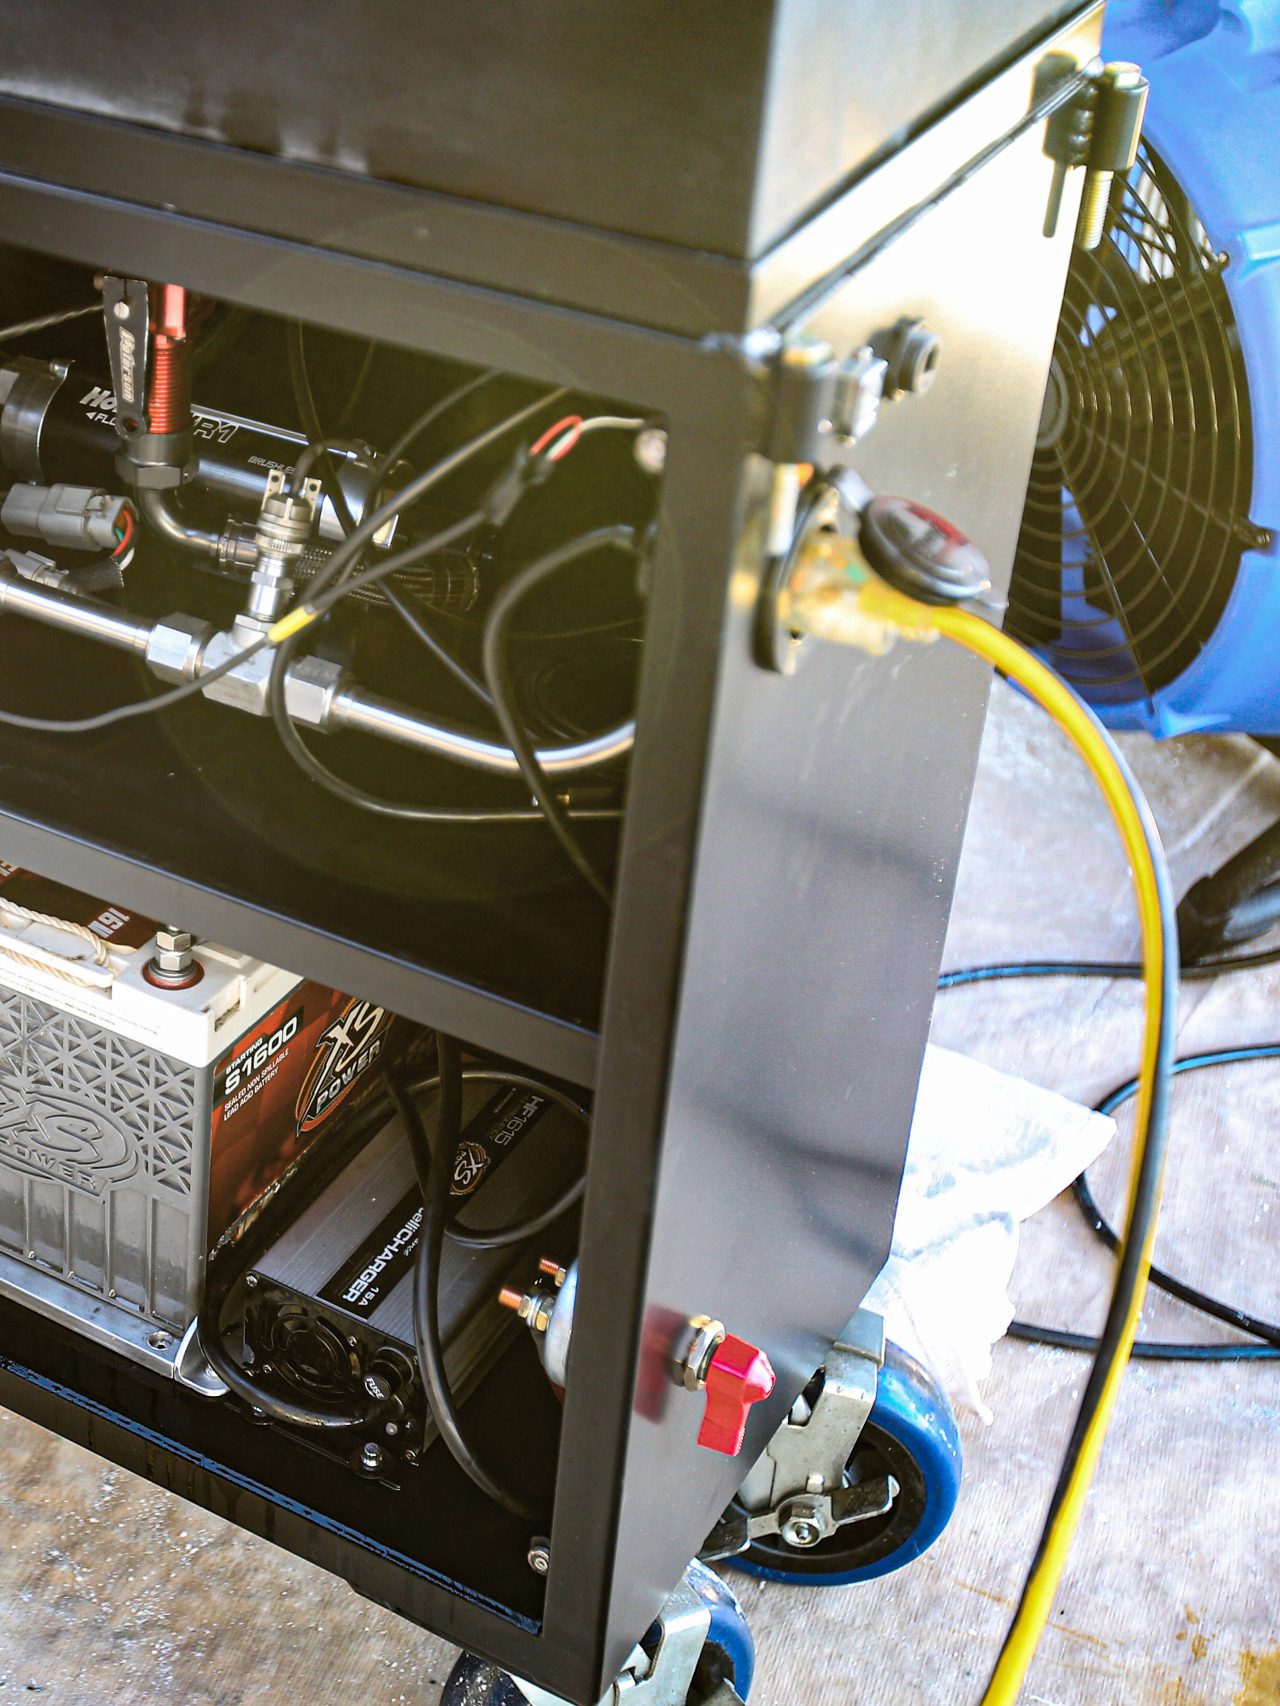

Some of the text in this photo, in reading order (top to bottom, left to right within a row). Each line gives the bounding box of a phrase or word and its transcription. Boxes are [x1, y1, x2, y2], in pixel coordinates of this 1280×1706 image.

[191, 413, 239, 444] R1
[87, 907, 130, 938] 16V
[225, 1037, 264, 1075] STARTING
[225, 1017, 297, 1095] S1600
[304, 1000, 385, 1126] XS
[316, 1040, 381, 1113] POWER
[223, 1066, 279, 1121] LEAD ACID BATTERY
[224, 1048, 289, 1112] SEALED NON SPILLABLE
[494, 1095, 544, 1146] HF1615
[454, 1149, 484, 1185] XS
[358, 1286, 380, 1306] 15A
[366, 1377, 385, 1399] FUSE
